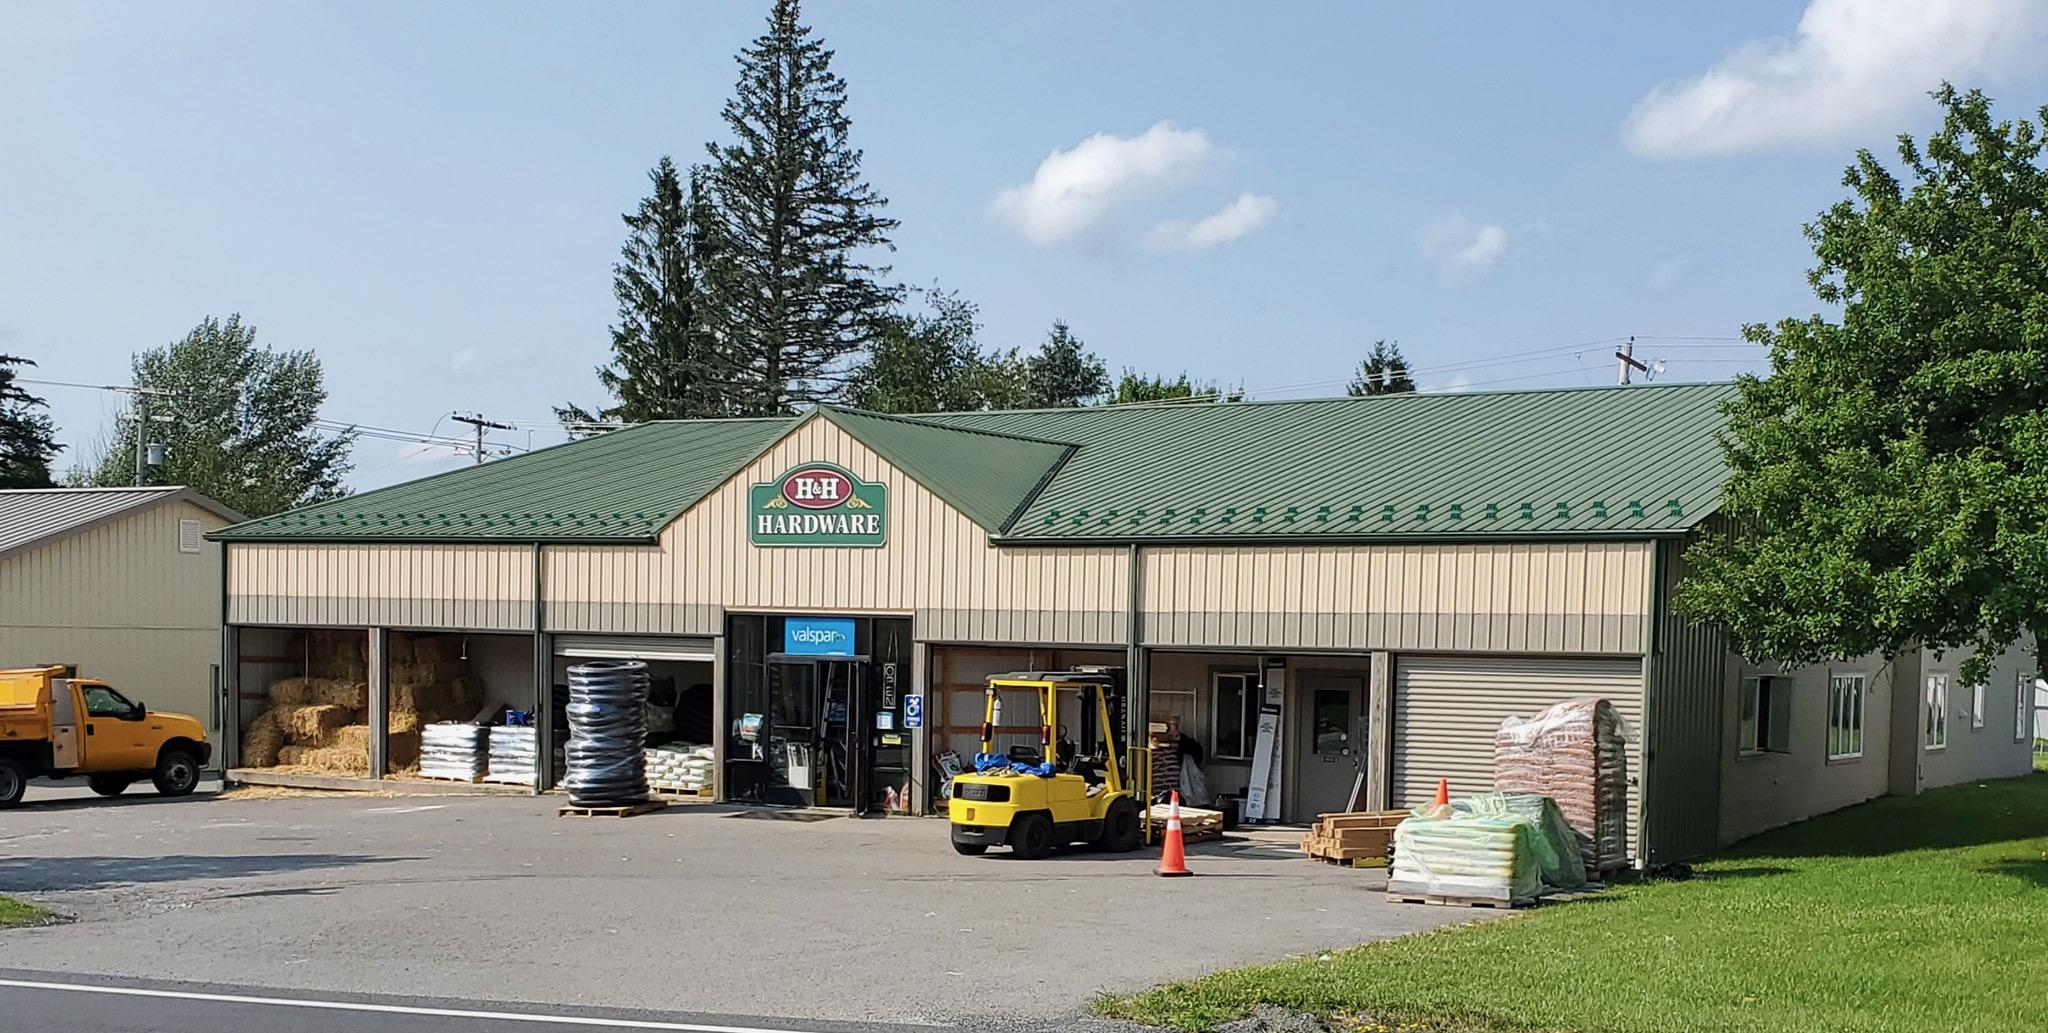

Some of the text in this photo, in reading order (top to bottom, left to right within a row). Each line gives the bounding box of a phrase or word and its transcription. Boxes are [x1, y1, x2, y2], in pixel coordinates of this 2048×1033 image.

[795, 477, 839, 499] H&H
[757, 514, 880, 534] HARDWARE
[791, 625, 838, 646] valspar
